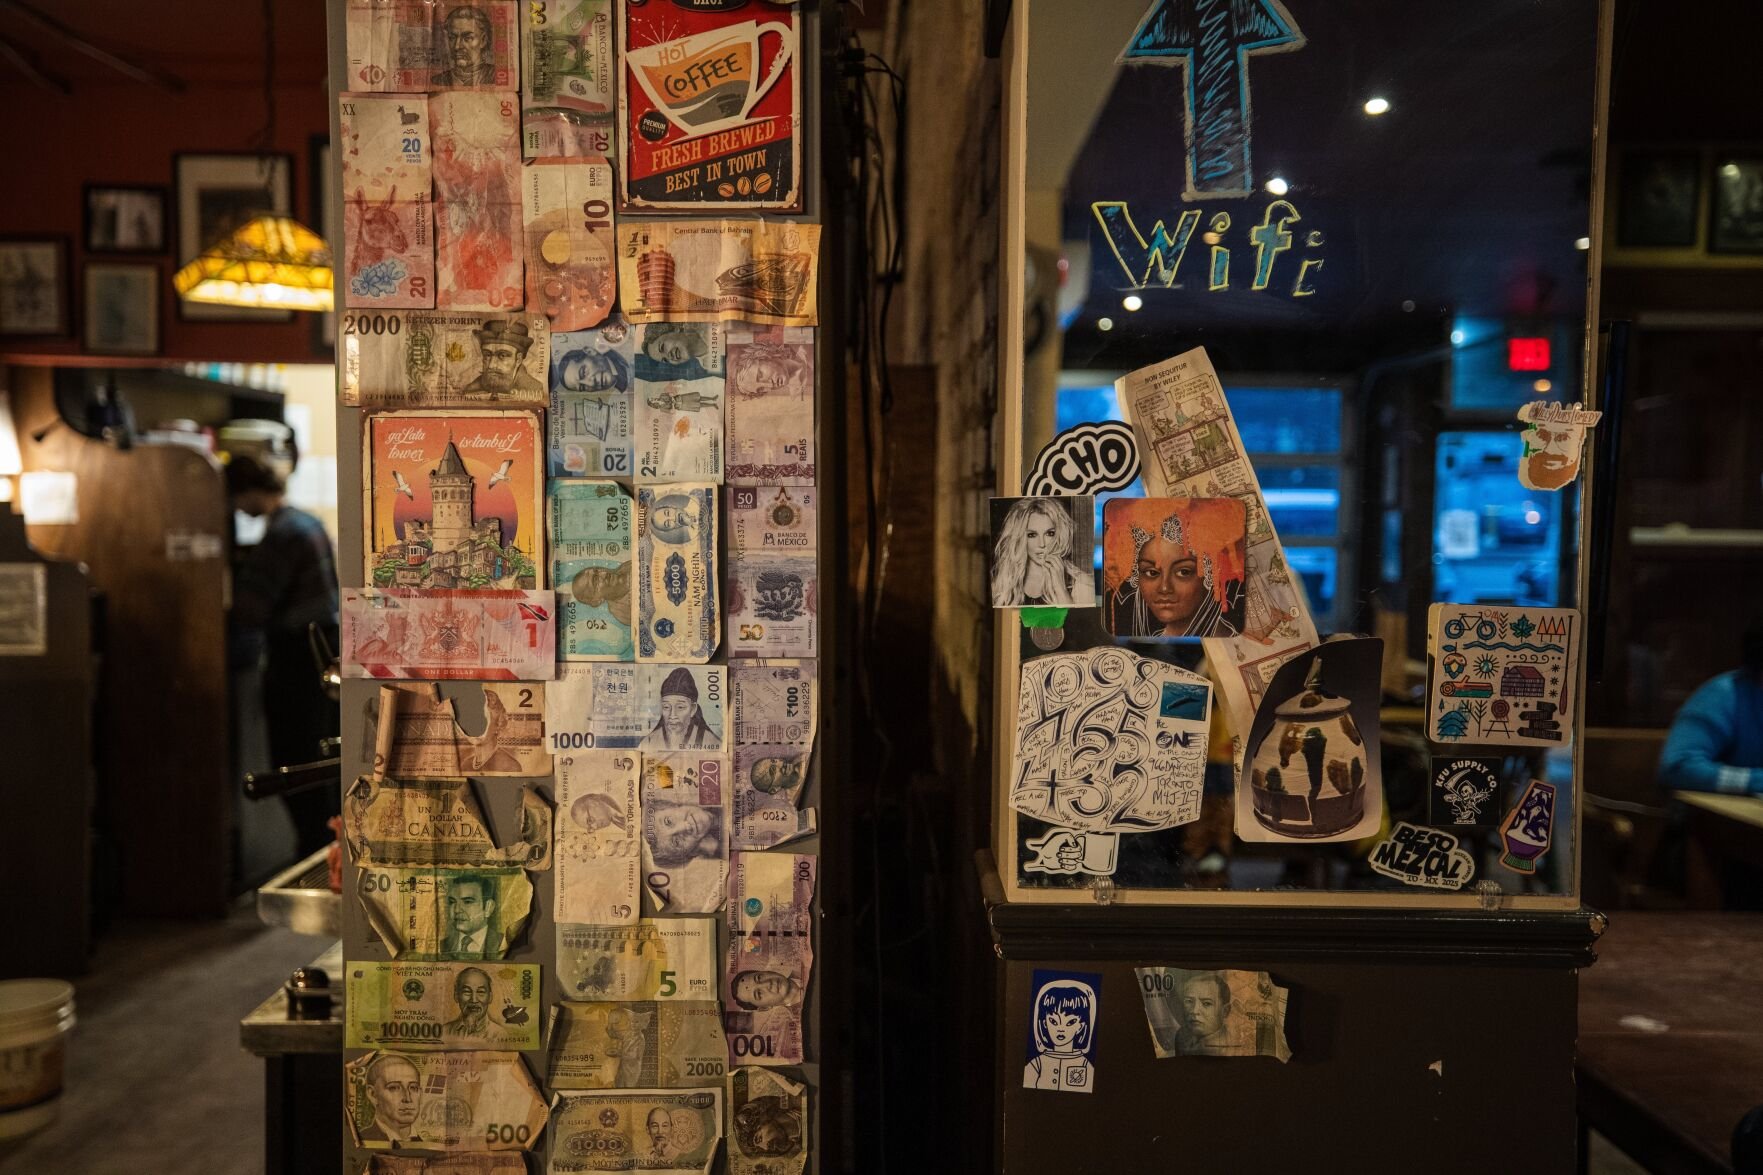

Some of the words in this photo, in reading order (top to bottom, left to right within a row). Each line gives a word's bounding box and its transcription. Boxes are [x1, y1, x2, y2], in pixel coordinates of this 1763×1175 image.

[599, 25, 607, 54] BANCO
[659, 41, 690, 66] HOT
[664, 52, 743, 98] COFFEE
[343, 104, 356, 116] XX
[500, 100, 512, 117] 50
[642, 118, 667, 130] PREMIUM
[402, 139, 421, 153] 20
[595, 132, 609, 152] 20
[652, 142, 702, 172] FRESH
[708, 120, 776, 157] BREWED
[665, 169, 699, 194] BEST
[706, 162, 722, 182] IN
[727, 150, 767, 173] TOWN
[584, 200, 610, 234] 10
[674, 227, 699, 235] Central
[700, 227, 718, 235] Bank
[409, 276, 427, 298] 20
[344, 315, 400, 335] 2000
[449, 317, 482, 326] FORINT
[1145, 374, 1158, 384] NON
[1159, 362, 1188, 379] SEQUITUR
[1153, 382, 1161, 390] BY
[1163, 374, 1180, 386] WILEY
[552, 417, 559, 426] de
[785, 445, 798, 455] 5
[604, 454, 626, 472] 20
[641, 462, 656, 477] 2
[737, 493, 753, 506] 50
[803, 495, 809, 505] 50
[607, 507, 618, 531] ₹50
[619, 498, 629, 531] 497665
[777, 537, 808, 546] MÉXICO
[672, 564, 680, 595] 5000
[567, 602, 576, 635] 497665
[525, 623, 537, 648] 1
[739, 624, 763, 641] 50
[707, 670, 720, 701] 1000
[518, 689, 533, 708] 2
[786, 686, 799, 717] ₹100
[802, 682, 810, 715] 836229
[550, 732, 595, 748] 1000
[1155, 730, 1202, 749] ONE
[614, 758, 634, 772] 5
[701, 761, 718, 787] 20
[1148, 757, 1165, 772] 966
[1151, 774, 1194, 791] TORONTO
[1435, 768, 1450, 787] KFU
[1451, 760, 1488, 774] SUPPLY
[1487, 775, 1497, 792] CO.
[418, 806, 432, 814] UN
[440, 792, 451, 813] 1
[408, 823, 485, 838] CANADA
[1393, 825, 1454, 851] BESO
[1373, 842, 1462, 878] MEZCAL
[800, 861, 810, 882] 100
[364, 874, 391, 893] 50
[1424, 877, 1438, 885] MX
[1442, 879, 1459, 887] 2025
[611, 905, 631, 919] 5
[660, 971, 676, 997] 5
[734, 1034, 774, 1057] 100
[686, 1062, 723, 1076] 2000
[485, 1124, 531, 1144] 500
